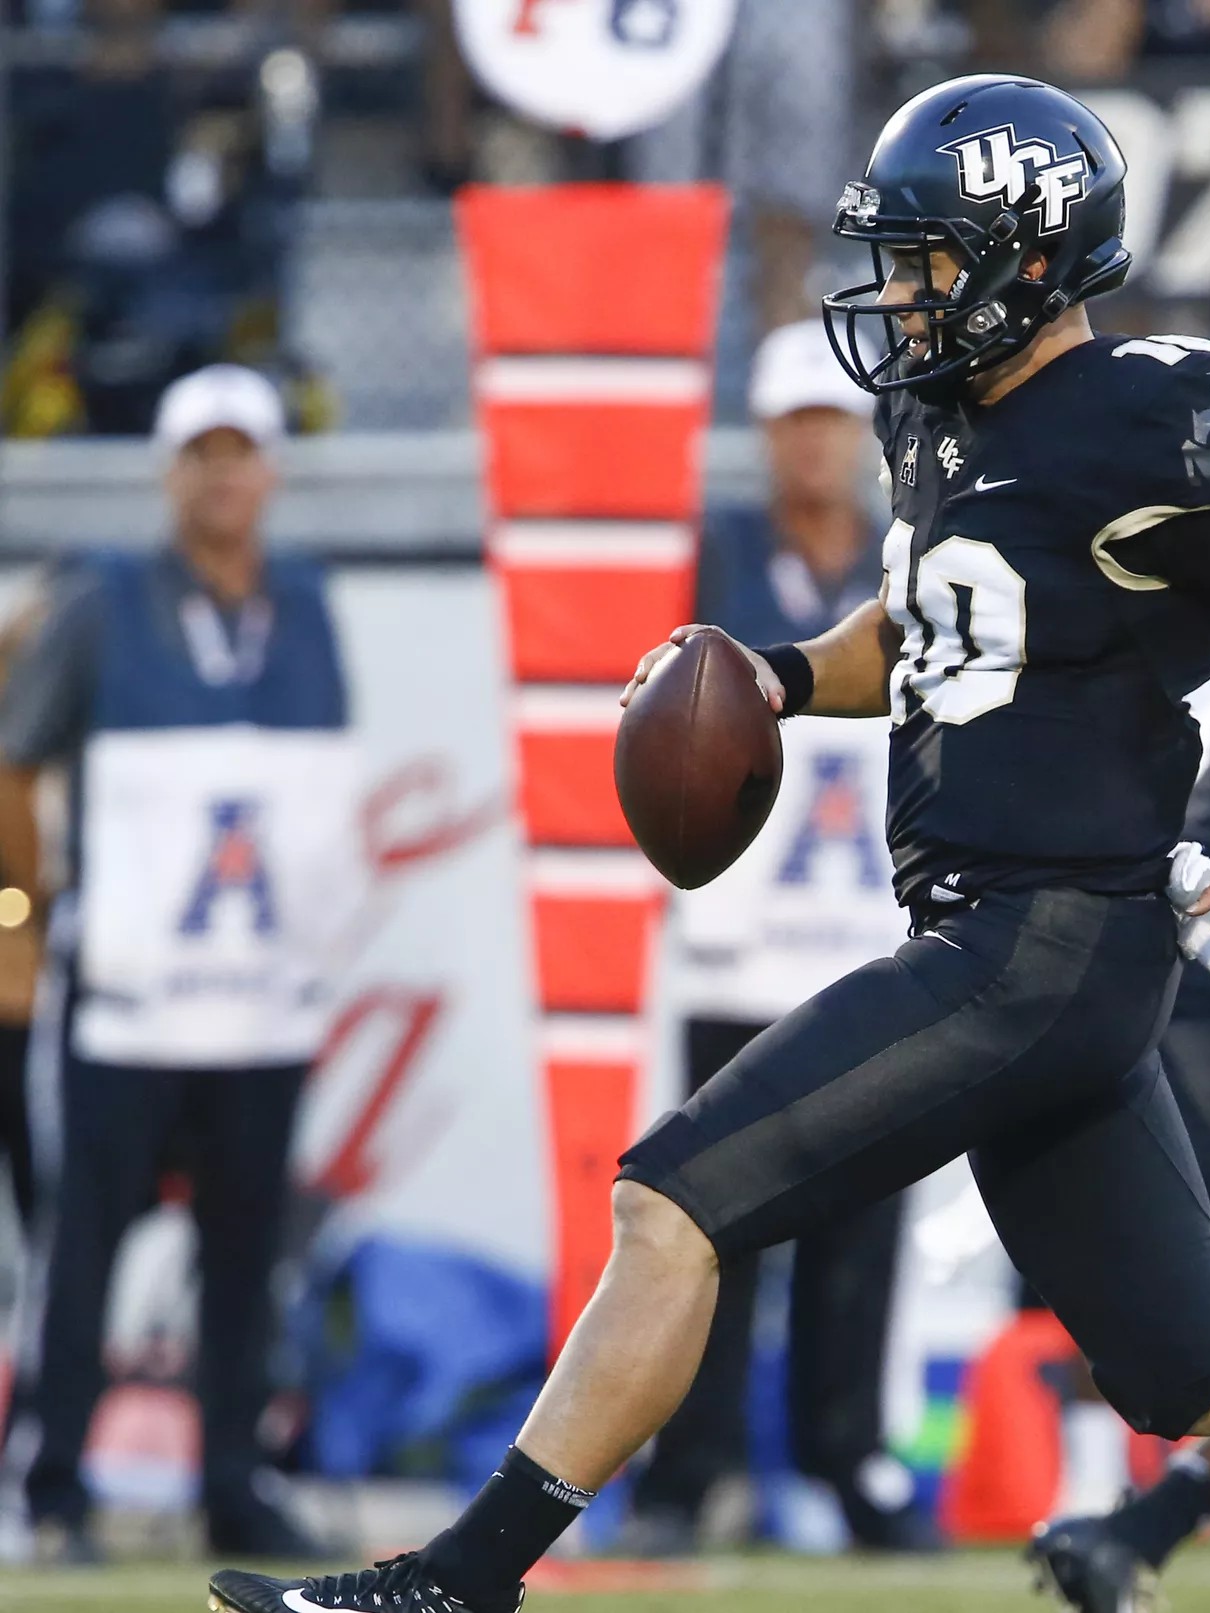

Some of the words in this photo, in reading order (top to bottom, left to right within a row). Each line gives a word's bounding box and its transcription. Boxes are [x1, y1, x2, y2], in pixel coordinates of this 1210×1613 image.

[936, 123, 1089, 236] UCF
[937, 436, 965, 479] UCF
[882, 518, 1027, 726] 10
[944, 873, 961, 887] M
